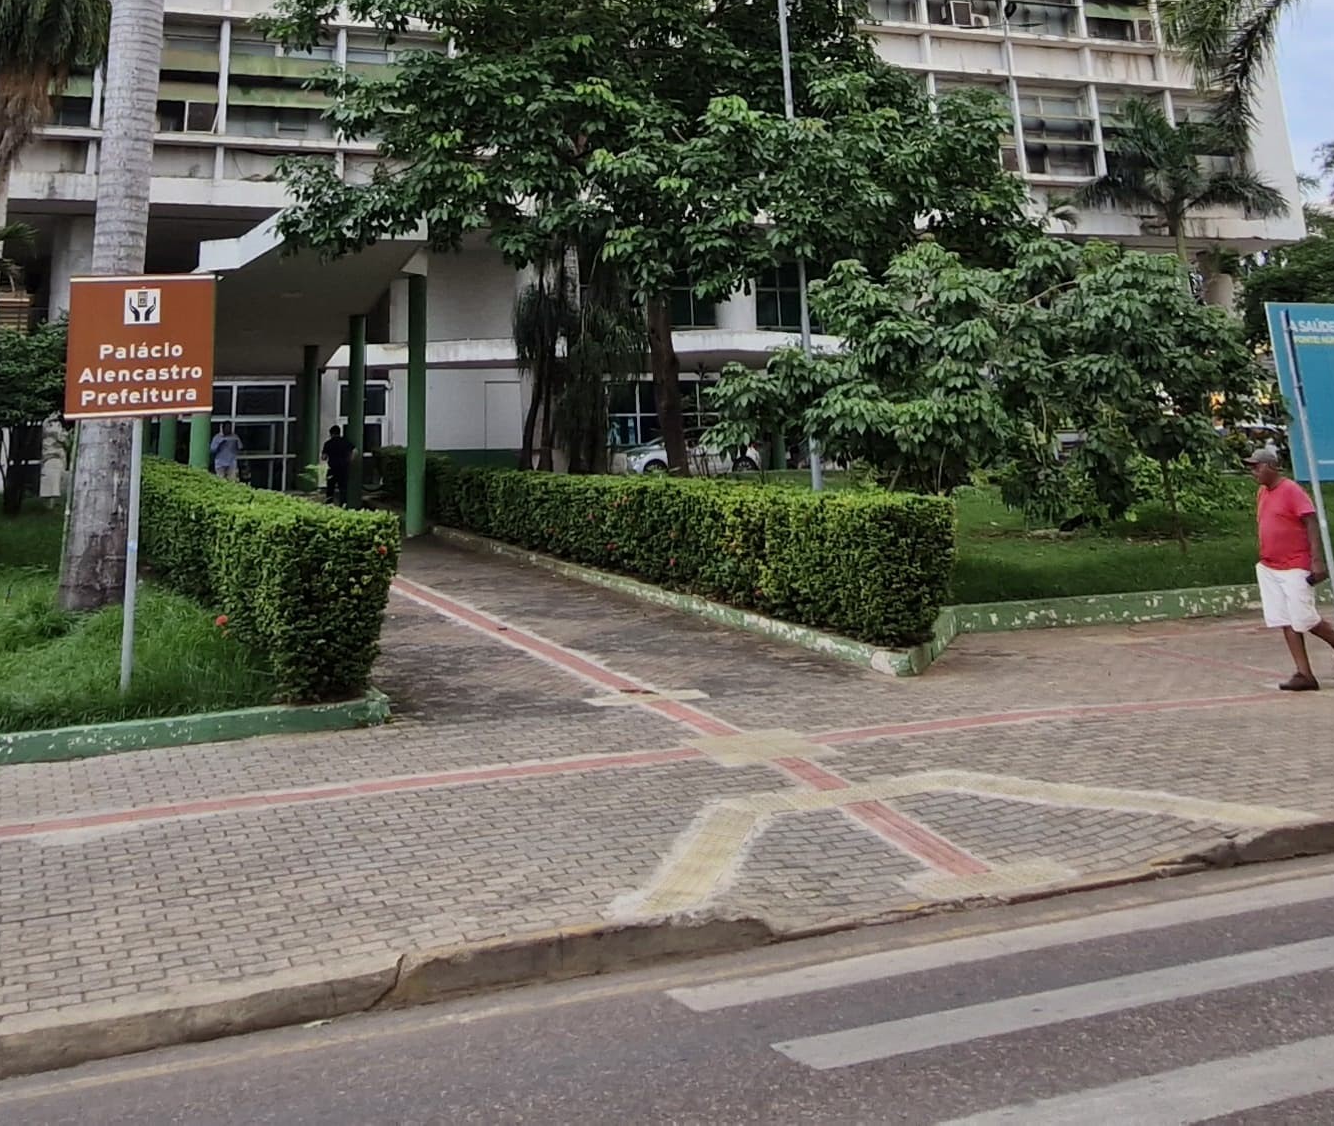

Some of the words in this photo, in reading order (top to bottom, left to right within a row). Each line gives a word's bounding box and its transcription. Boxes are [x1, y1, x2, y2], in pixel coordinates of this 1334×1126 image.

[99, 342, 183, 360] Palácio
[78, 365, 203, 384] Alencastro
[81, 387, 197, 406] Prefeitura
